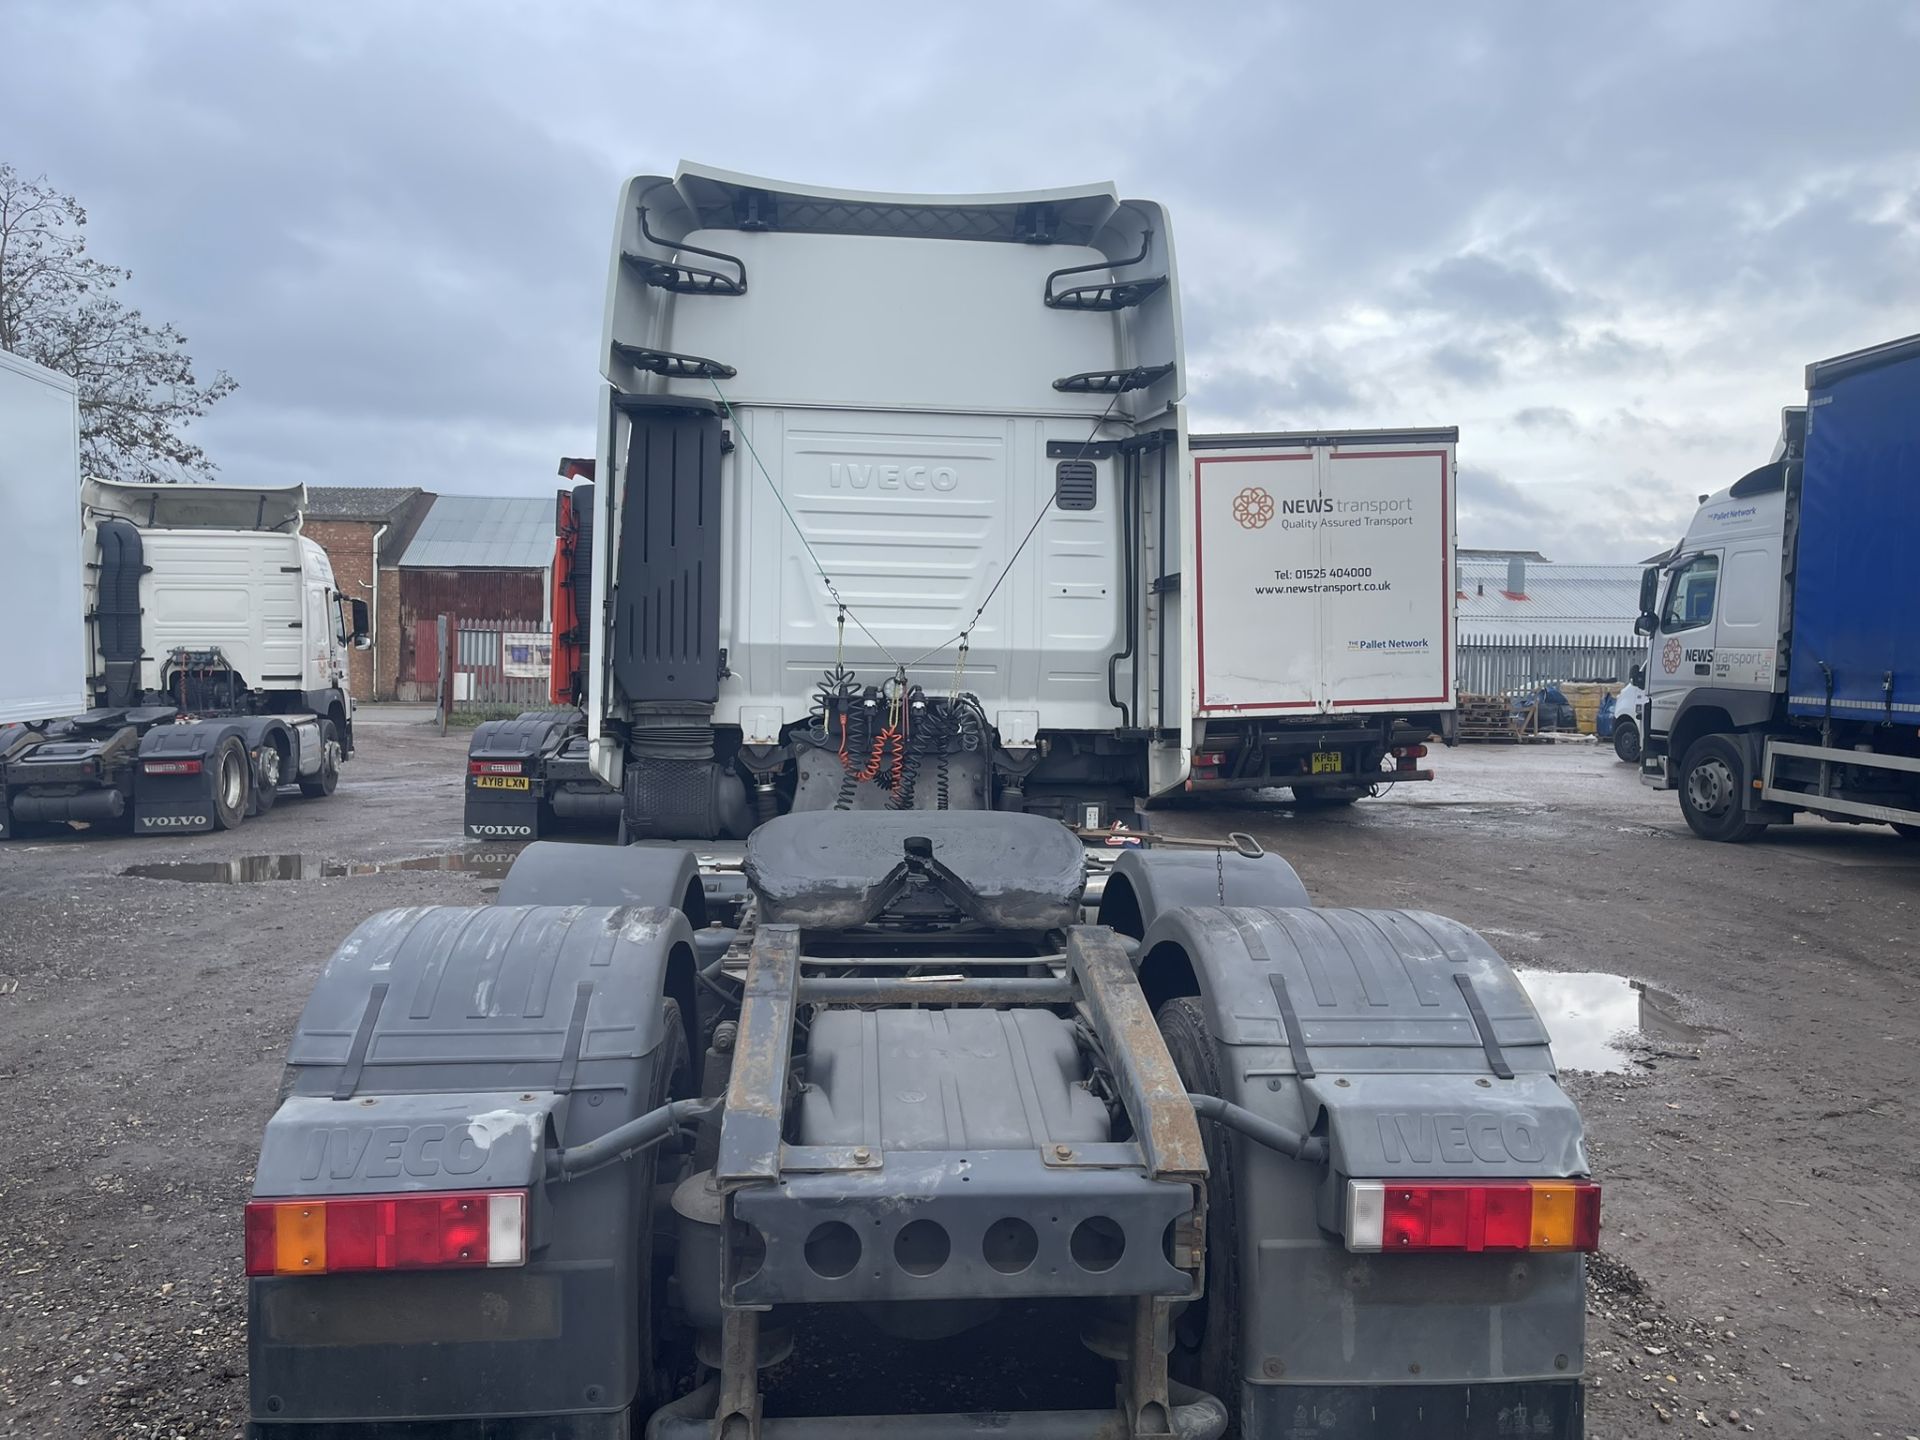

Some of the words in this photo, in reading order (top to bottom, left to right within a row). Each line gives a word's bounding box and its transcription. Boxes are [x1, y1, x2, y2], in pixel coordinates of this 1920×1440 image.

[830, 463, 958, 492] IVECO
[1282, 498, 1334, 514] NEWS
[1337, 497, 1413, 514] transport
[1281, 518, 1318, 531] Quality
[1320, 517, 1361, 528] Assured
[1364, 516, 1413, 528] Transport
[1274, 569, 1293, 580] Tel:
[1295, 568, 1327, 580] 01525
[1329, 567, 1372, 579] 404000
[1255, 581, 1391, 595] www.newstransport.co.uk
[1360, 640, 1387, 649] Pallet
[1388, 638, 1429, 648] Network
[1685, 648, 1714, 663] NEWS
[1715, 650, 1762, 667] transport
[481, 776, 504, 787] AY18
[505, 778, 526, 788] LXN
[142, 815, 207, 827] VOLVO
[470, 824, 531, 835] VOLVO
[1376, 1113, 1547, 1164] IVECO
[301, 1123, 491, 1181] IVECO
